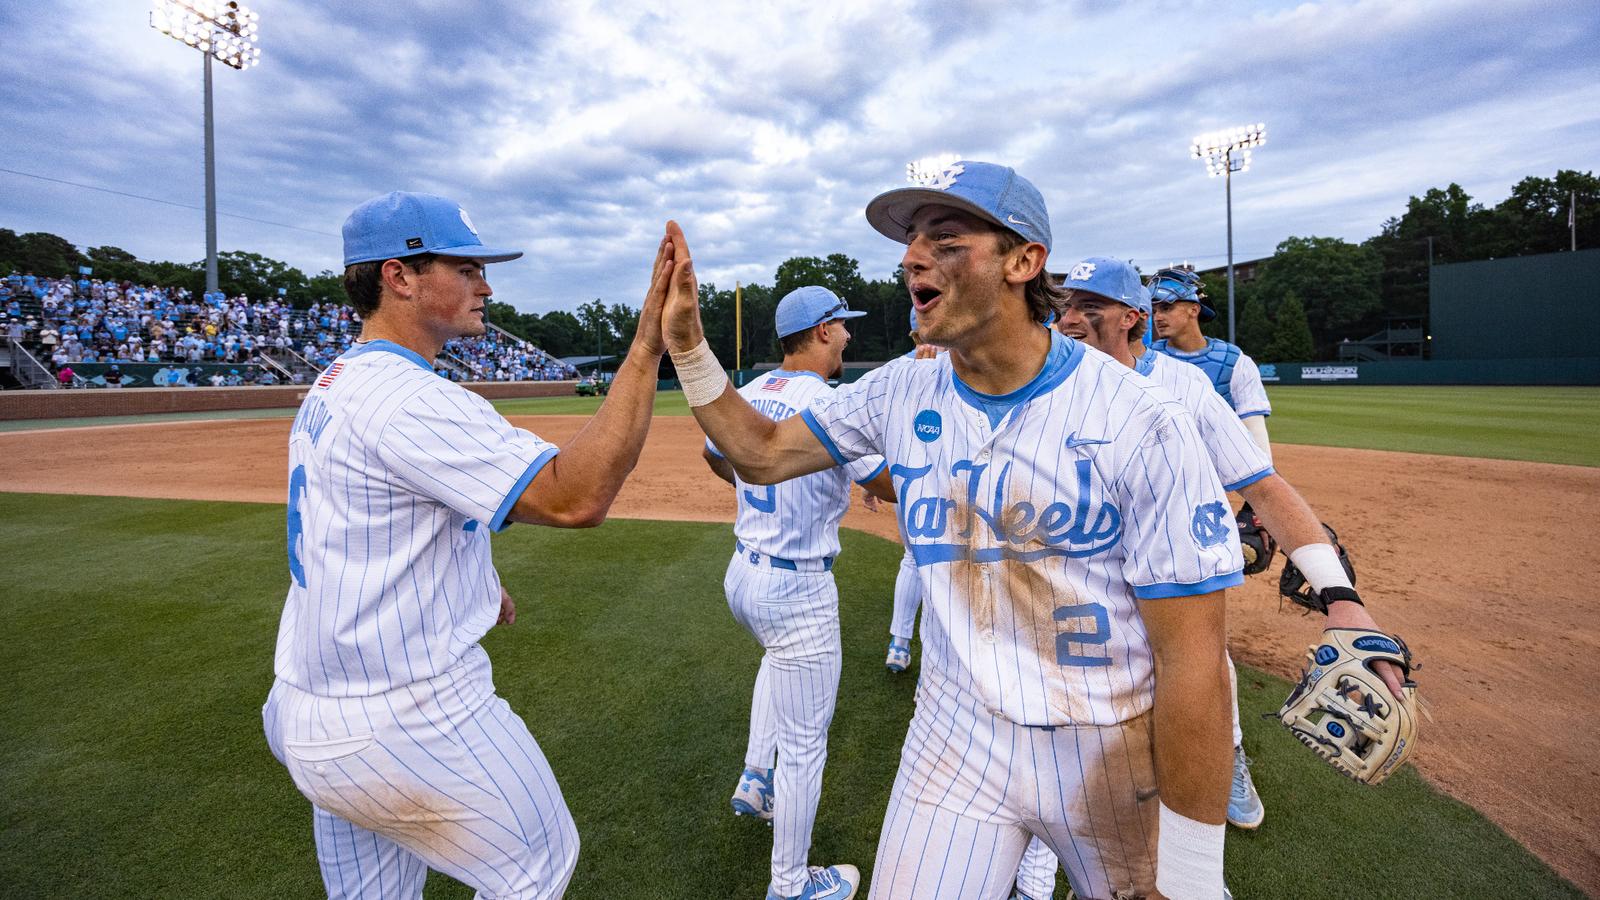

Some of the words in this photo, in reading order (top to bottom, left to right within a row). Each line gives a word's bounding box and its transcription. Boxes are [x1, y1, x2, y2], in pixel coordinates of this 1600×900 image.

[917, 423, 941, 435] NCAA
[890, 463, 957, 539] Tar
[951, 459, 1121, 545] Heels
[1052, 602, 1113, 667] 2
